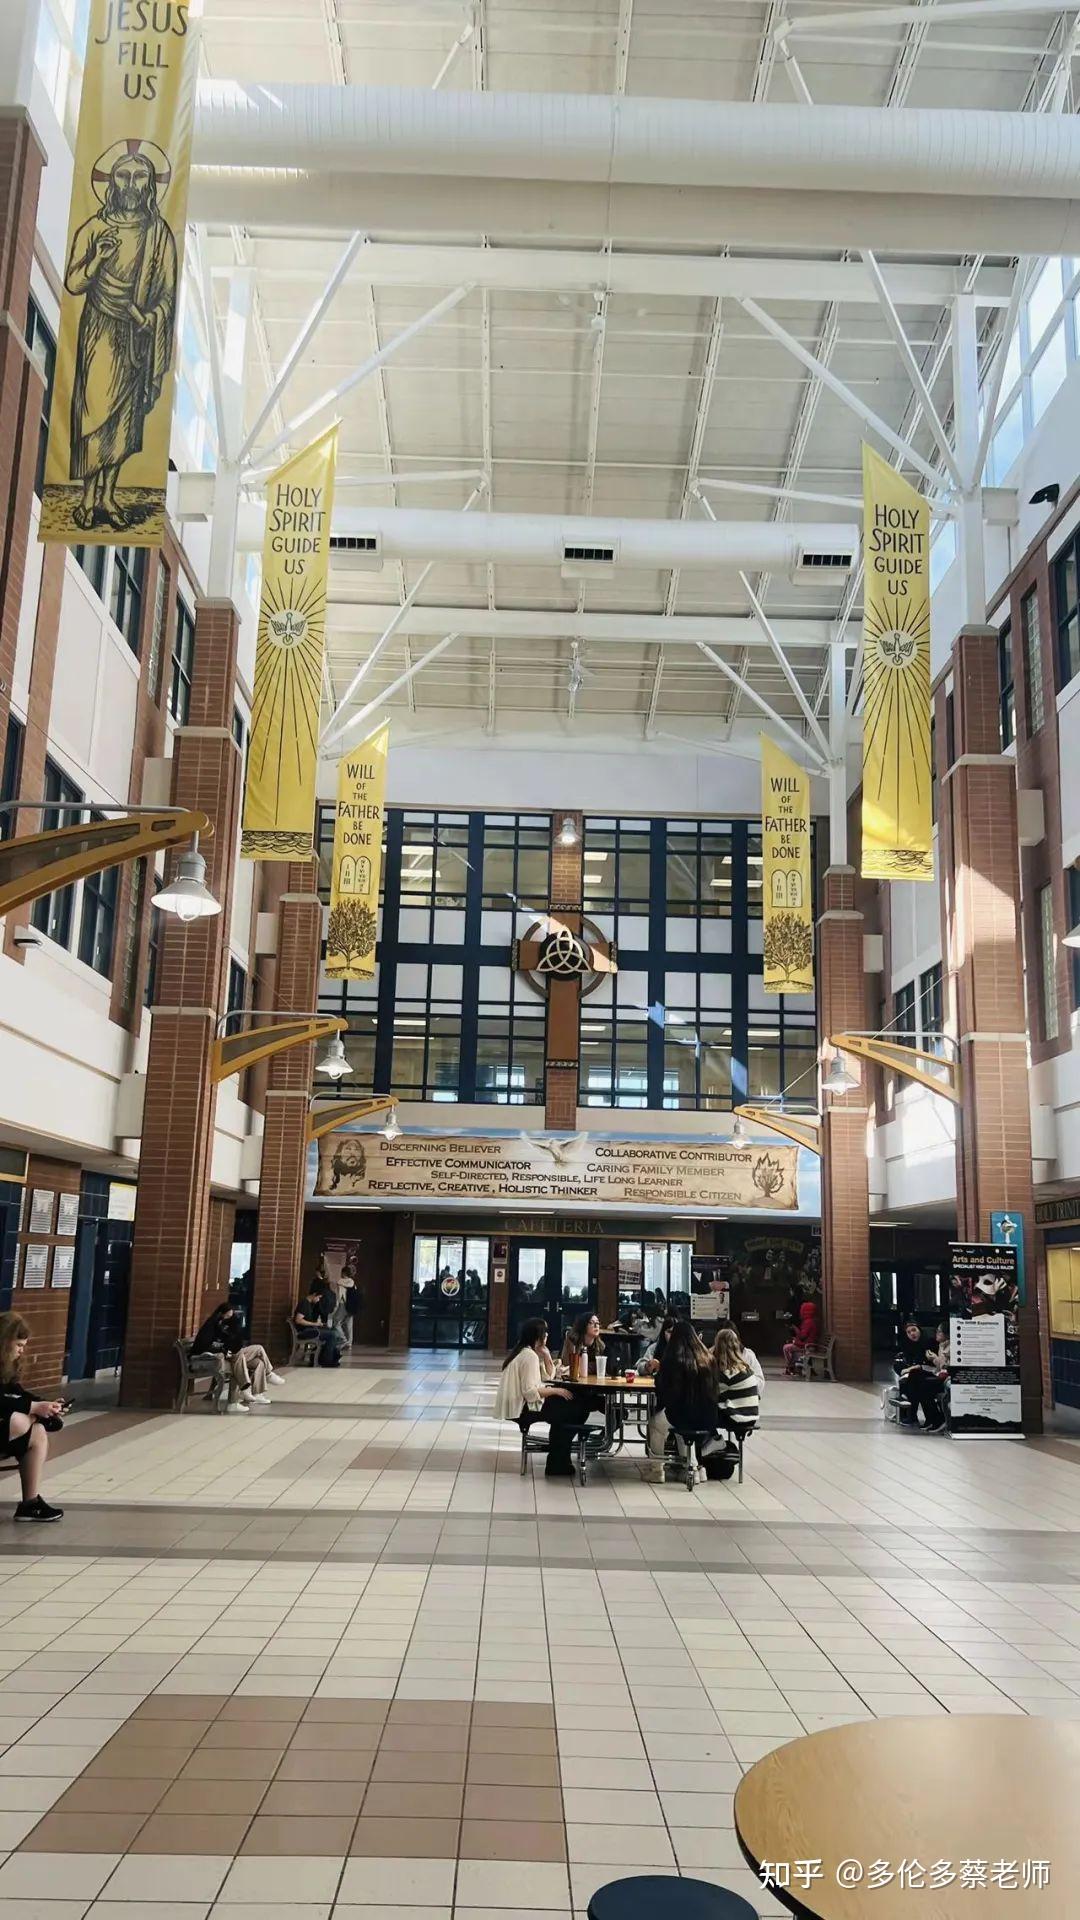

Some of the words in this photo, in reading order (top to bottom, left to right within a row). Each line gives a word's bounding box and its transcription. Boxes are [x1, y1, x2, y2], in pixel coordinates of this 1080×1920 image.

[95, 0, 188, 44] JESUS
[119, 42, 169, 68] FILL
[124, 74, 157, 101] US
[277, 484, 322, 507] HOLY
[269, 508, 326, 532] SPIRIT
[875, 504, 920, 529] HOLY
[272, 536, 322, 554] GUIDE
[869, 528, 925, 554] SPIRIT
[284, 559, 306, 575] US
[874, 556, 923, 574] GUIDE
[888, 580, 908, 596] US
[346, 763, 376, 780] WILL
[356, 782, 366, 791] OF
[770, 777, 800, 793] WILL
[352, 792, 368, 801] THE
[781, 795, 791, 804] OF
[338, 801, 380, 820] FATHER
[778, 806, 793, 814] THE
[353, 821, 363, 831] BE
[764, 815, 807, 833] FATHER
[343, 832, 372, 845] DONE
[780, 834, 791, 845] BE
[772, 846, 800, 859] DONE
[380, 1142, 446, 1153] DISCERNING
[450, 1143, 502, 1154] BELIEVER
[595, 1147, 677, 1160] COLLABORATIVE
[679, 1150, 752, 1162] CONTRIBUTOR
[386, 1156, 442, 1168] EFFECTIVE
[445, 1158, 532, 1170] COMMUNICATOR
[586, 1162, 630, 1174] CARING
[632, 1164, 674, 1175] FAMILY
[676, 1166, 725, 1177] MEMBER
[431, 1171, 509, 1182] SELF-DIRECTED,
[512, 1172, 581, 1184] RESPONSIBLE,
[584, 1175, 606, 1184] LIFE
[608, 1176, 636, 1186] LONG
[638, 1177, 683, 1187] LEARNER
[368, 1180, 435, 1192] REFLECTIVE,
[498, 1184, 548, 1194] HOLISTIC
[550, 1185, 598, 1196] THINKER
[624, 1188, 696, 1199] RESPONSIBLE
[699, 1190, 742, 1201] CITIZEN
[504, 1218, 605, 1234] CAFETERIA
[952, 1255, 968, 1263] Arts
[970, 1256, 984, 1264] and
[986, 1256, 1015, 1265] Culture
